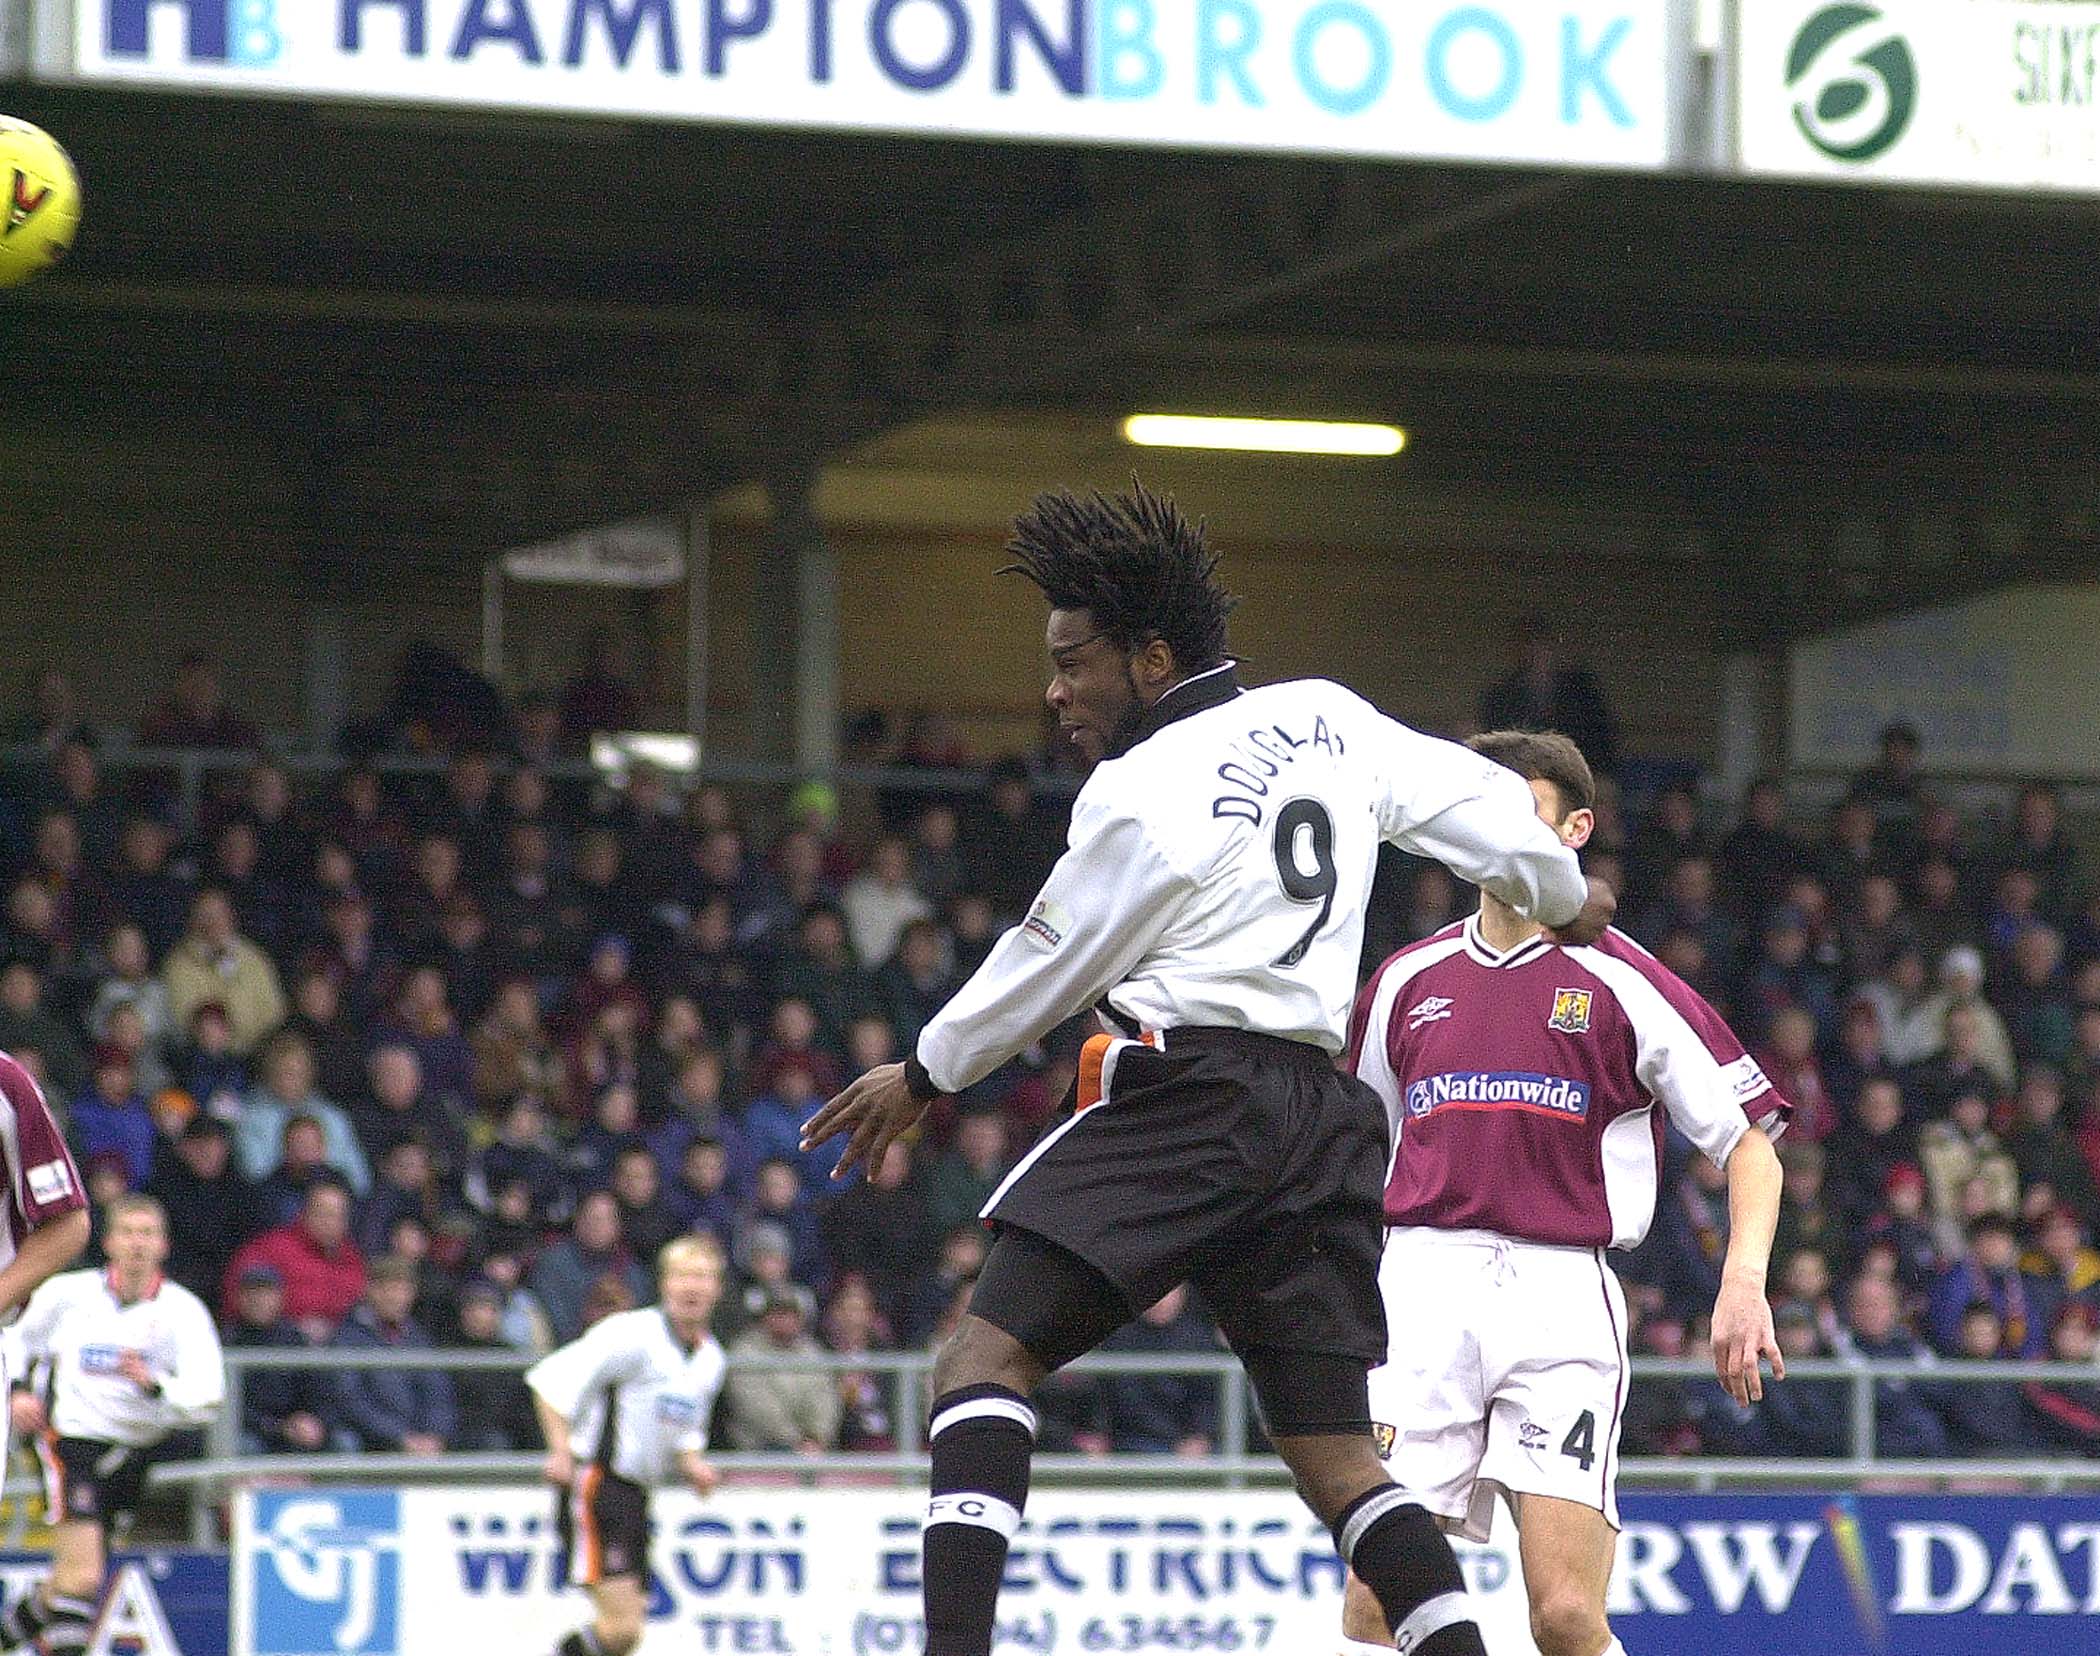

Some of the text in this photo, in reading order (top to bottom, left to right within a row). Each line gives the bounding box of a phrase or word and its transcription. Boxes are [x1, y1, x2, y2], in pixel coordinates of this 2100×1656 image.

[1270, 794, 1338, 969] 9
[1431, 1073, 1583, 1112] Nationwide
[1561, 1409, 1595, 1472] 4
